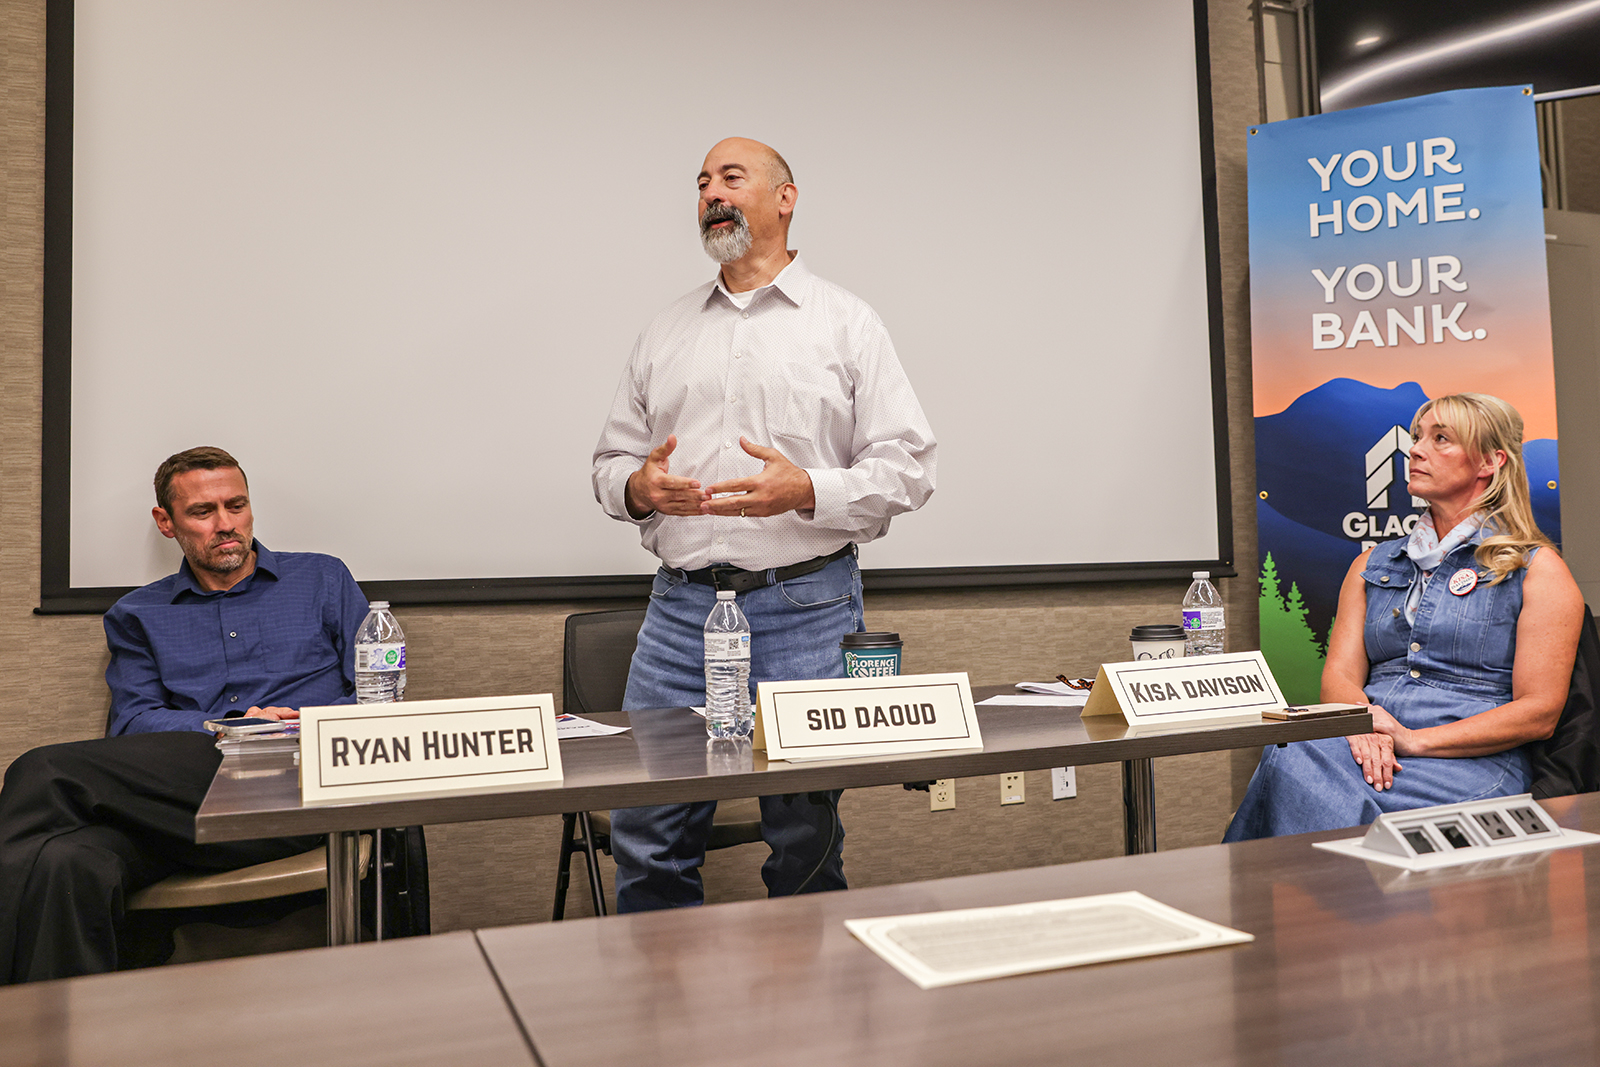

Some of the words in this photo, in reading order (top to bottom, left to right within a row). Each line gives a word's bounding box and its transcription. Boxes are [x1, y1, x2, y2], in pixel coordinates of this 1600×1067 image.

[1307, 136, 1463, 192] YOUR
[1309, 182, 1481, 238] HOME.
[1311, 255, 1468, 303] YOUR
[1312, 302, 1487, 350] BANK.
[1342, 511, 1420, 538] GLAC
[851, 658, 895, 668] FLORENCE
[852, 666, 895, 678] COFFEE
[1129, 682, 1181, 704] KISA
[1181, 674, 1265, 699] DAVISON
[806, 707, 847, 731] SID
[854, 703, 937, 729] DAOUD
[331, 736, 411, 767] RYAN
[422, 728, 534, 761] HUNTER
